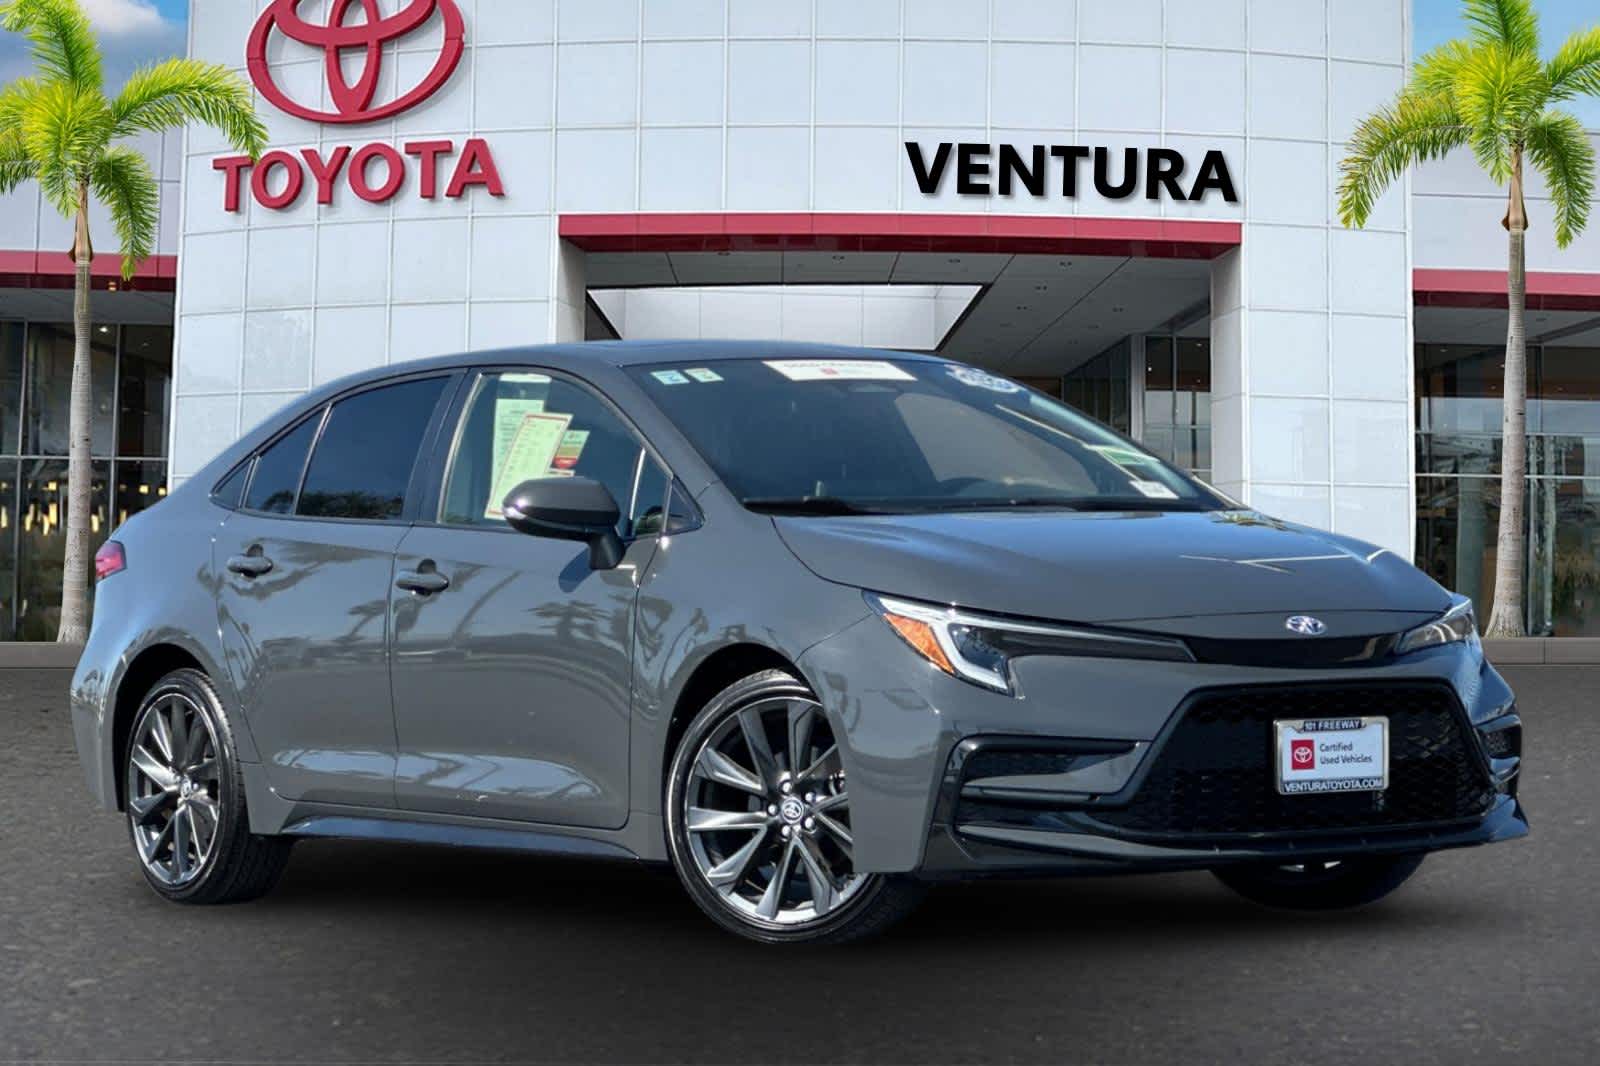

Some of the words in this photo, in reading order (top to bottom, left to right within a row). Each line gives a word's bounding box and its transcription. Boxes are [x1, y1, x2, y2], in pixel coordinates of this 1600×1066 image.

[212, 139, 505, 212] TOYOTA
[904, 142, 1239, 202] VENTURA
[1318, 719, 1360, 730] FREEWAY
[1319, 742, 1353, 753] Certified
[1319, 756, 1340, 765] Used
[1341, 753, 1373, 764] Vehicles
[1284, 778, 1384, 793] VENTURATOYOTA.COM
